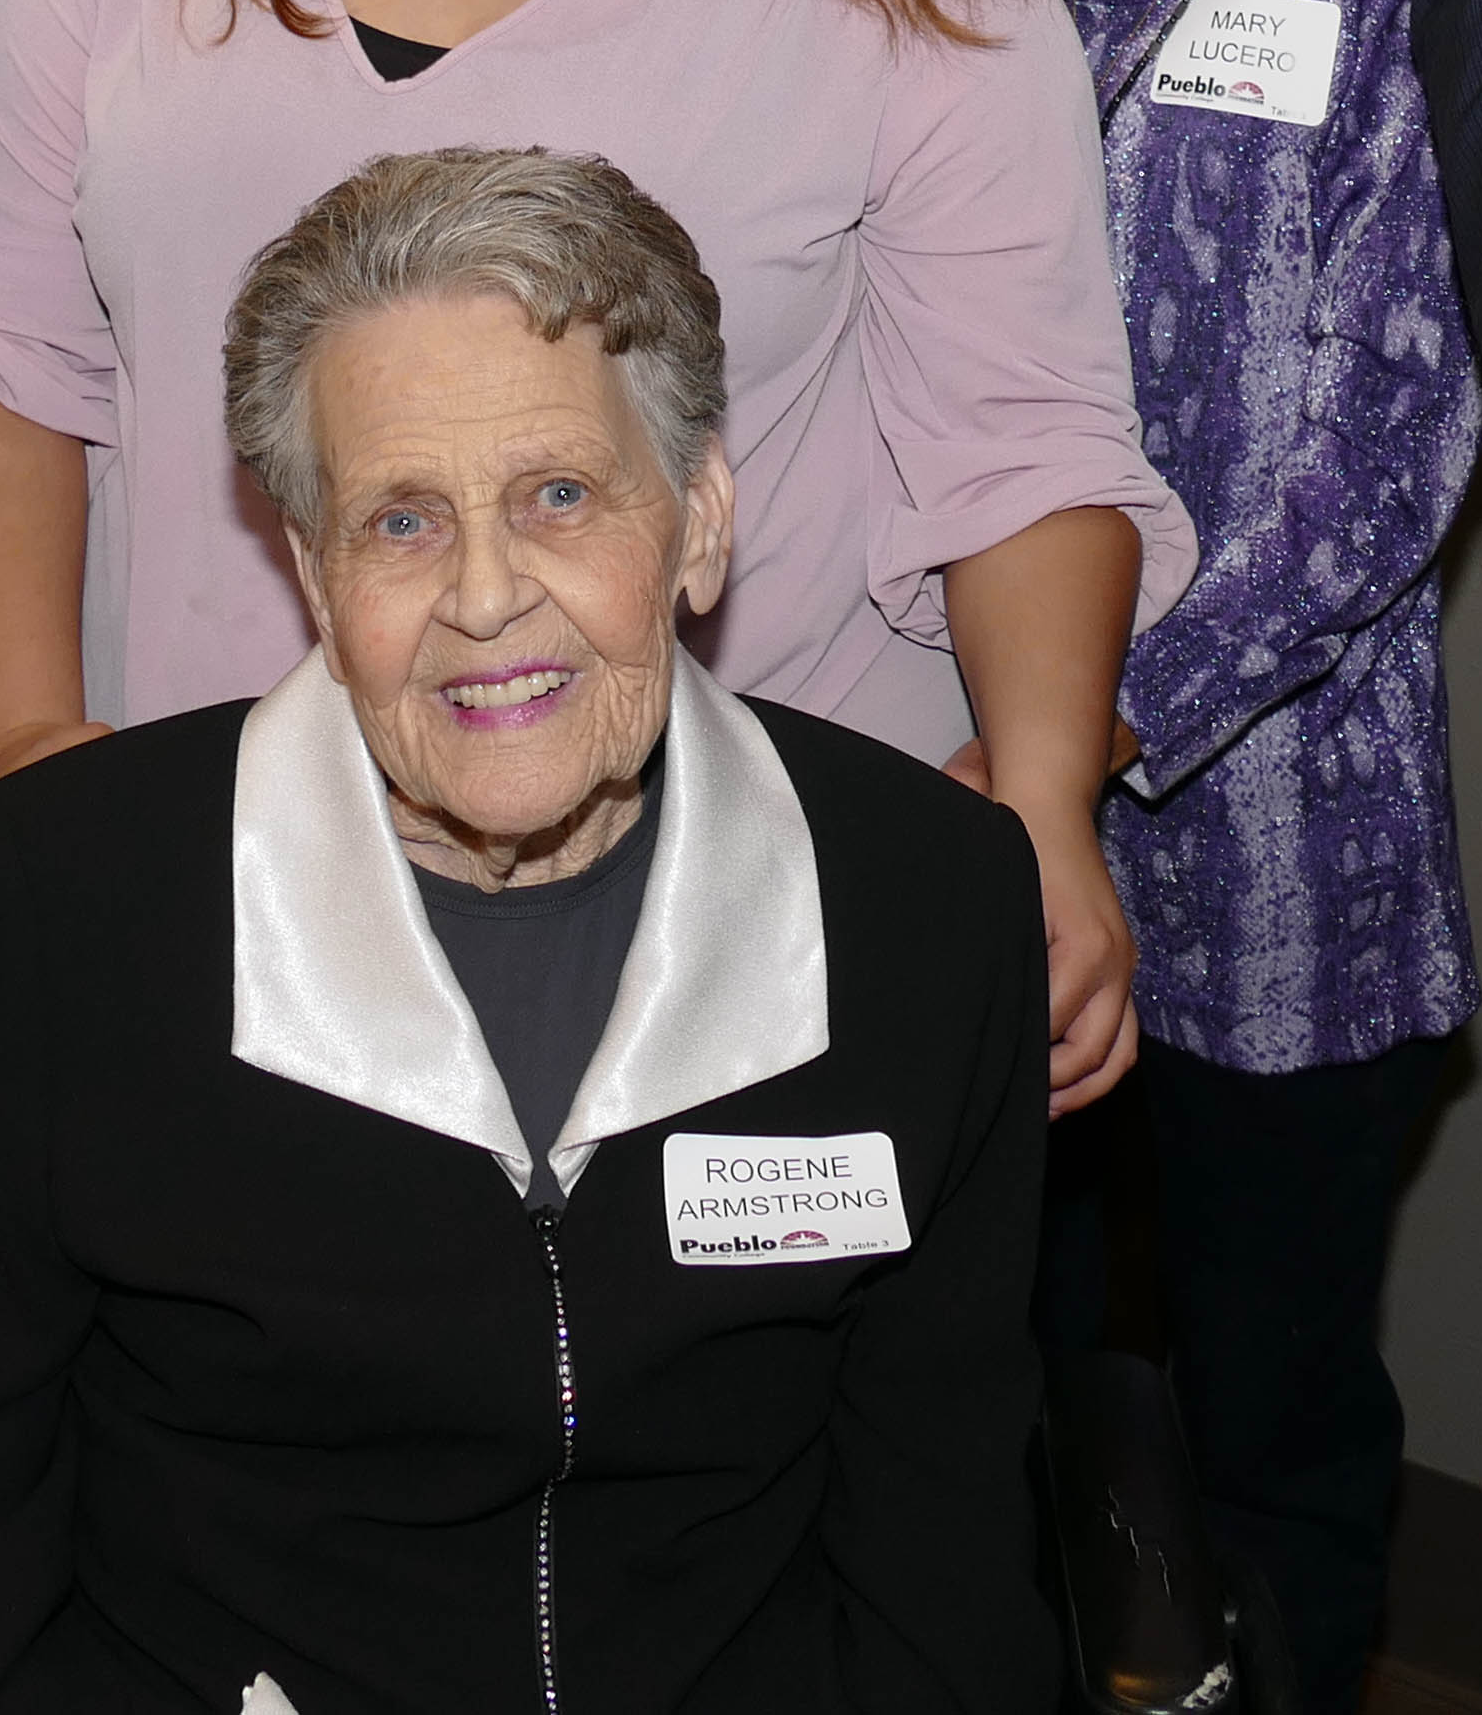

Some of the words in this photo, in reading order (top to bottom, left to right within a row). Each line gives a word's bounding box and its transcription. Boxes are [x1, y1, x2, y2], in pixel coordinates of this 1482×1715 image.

[1210, 10, 1286, 36] MARY
[1189, 40, 1296, 72] LUCERO
[1157, 73, 1226, 97] Pueblo
[706, 1155, 852, 1183] ROGENE
[677, 1189, 888, 1221] ARMSTRONG
[679, 1235, 777, 1254] Pueblo
[843, 1240, 878, 1251] Table
[881, 1240, 890, 1248] 3
